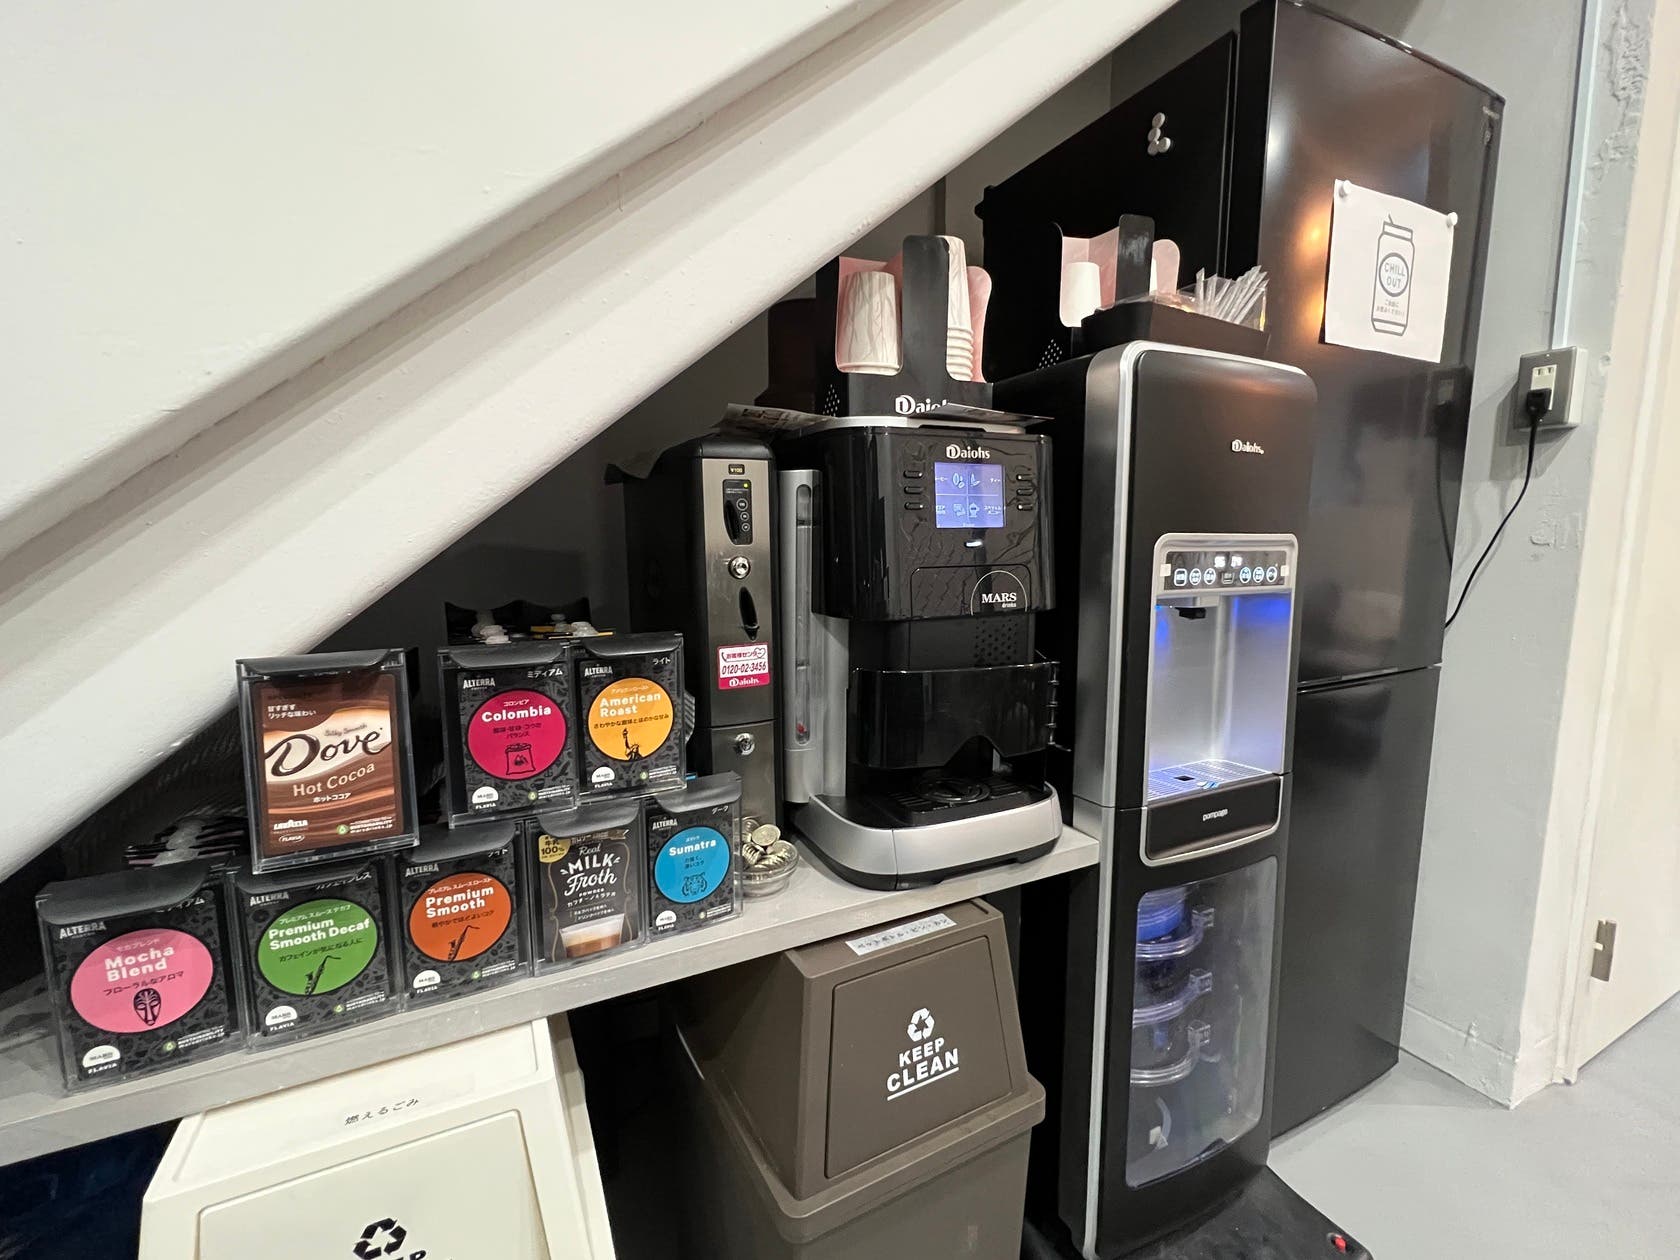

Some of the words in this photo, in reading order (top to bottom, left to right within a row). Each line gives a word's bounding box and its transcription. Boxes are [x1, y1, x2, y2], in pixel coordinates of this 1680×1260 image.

[1384, 262, 1406, 277] CHILL
[1386, 276, 1402, 289] OUT
[946, 444, 991, 459] Daiohs
[981, 592, 1017, 603] MARS
[527, 668, 563, 679] ミディアム
[722, 661, 767, 675] 0120-02-3456
[463, 677, 495, 689] ALTERRA
[600, 693, 661, 708] American
[481, 705, 552, 722] Colombia
[600, 705, 638, 718] Roast
[264, 728, 383, 777] Dove
[293, 782, 322, 797] Hot
[327, 763, 376, 788] Cocoa
[669, 839, 717, 856] Sumatra
[405, 863, 440, 877] ALTERRA
[568, 853, 616, 875] MILK
[564, 869, 618, 897] Froth
[425, 886, 494, 908] Premium
[426, 898, 486, 919] Smooth
[59, 921, 107, 940] ALTERRA
[268, 919, 334, 940] Premium
[269, 930, 326, 951] Smooth
[329, 918, 371, 937] Decaf
[104, 946, 175, 971] Mocha
[107, 957, 168, 982] Blend
[899, 1037, 945, 1068] KEEP
[88, 1063, 118, 1075] FLAVIA
[886, 1048, 959, 1092] CLEAN
[344, 1098, 419, 1126] 燃えるごみ
